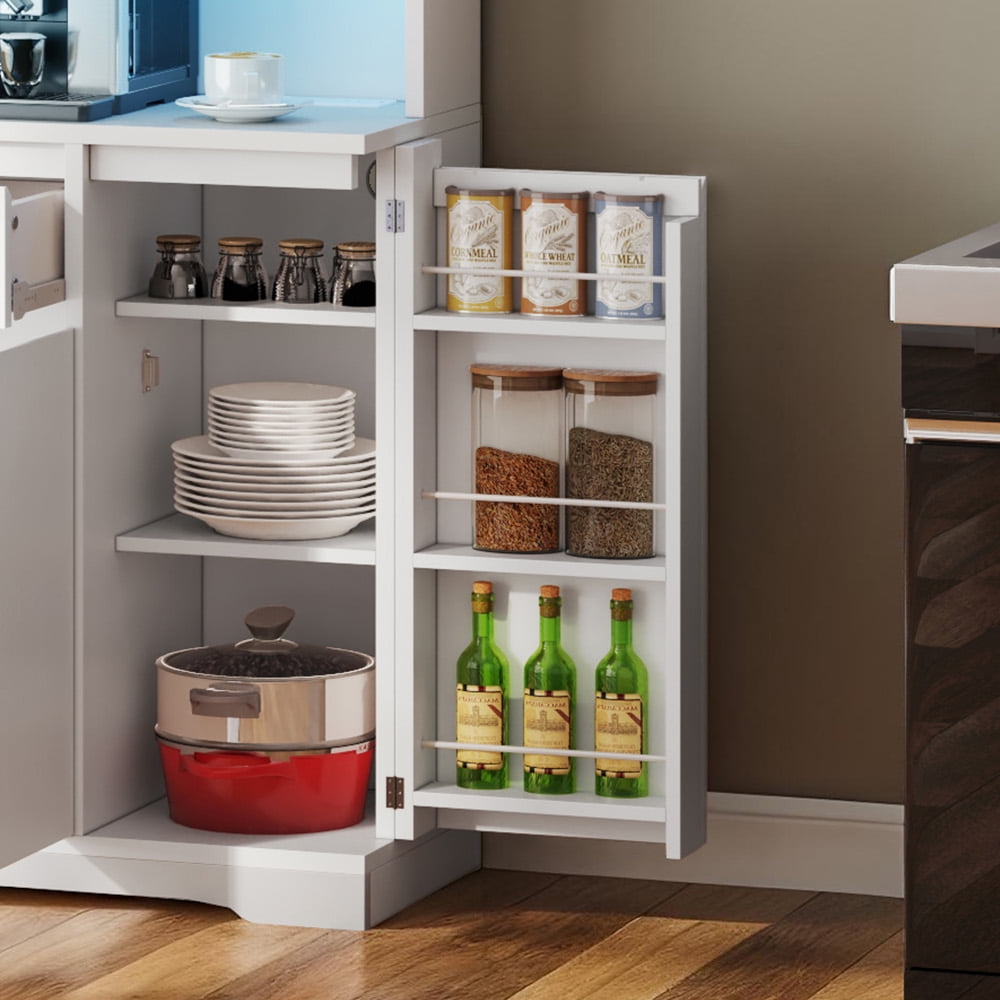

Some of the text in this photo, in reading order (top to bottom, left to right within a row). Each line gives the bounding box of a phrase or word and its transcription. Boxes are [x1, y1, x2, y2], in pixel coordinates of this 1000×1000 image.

[451, 247, 498, 258] CORNMEAL
[548, 252, 575, 261] WHEAT
[600, 252, 646, 264] OATMEAL
